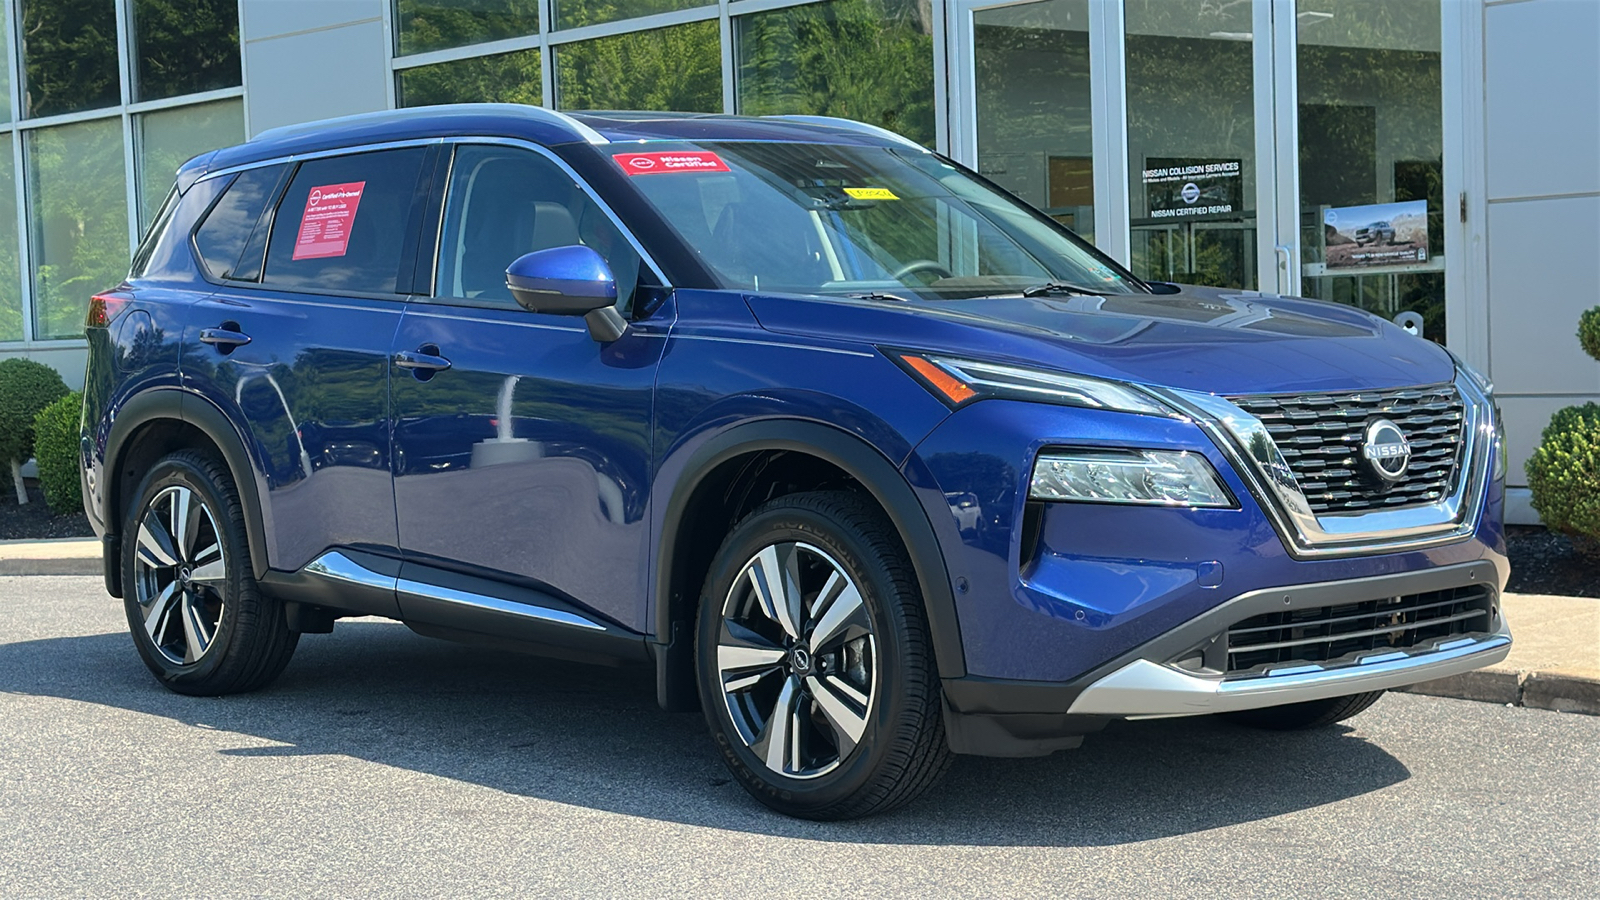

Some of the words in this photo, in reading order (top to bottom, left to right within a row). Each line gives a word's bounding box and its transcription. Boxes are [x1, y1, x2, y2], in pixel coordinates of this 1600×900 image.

[1142, 168, 1168, 178] NISSAN
[1169, 166, 1204, 175] COLLISION
[1205, 162, 1239, 172] SERVICES
[1151, 209, 1175, 218] NISSAN
[1176, 206, 1208, 216] CERTIFIED
[1208, 204, 1232, 213] REPAIR
[1366, 444, 1411, 457] NISSAN
